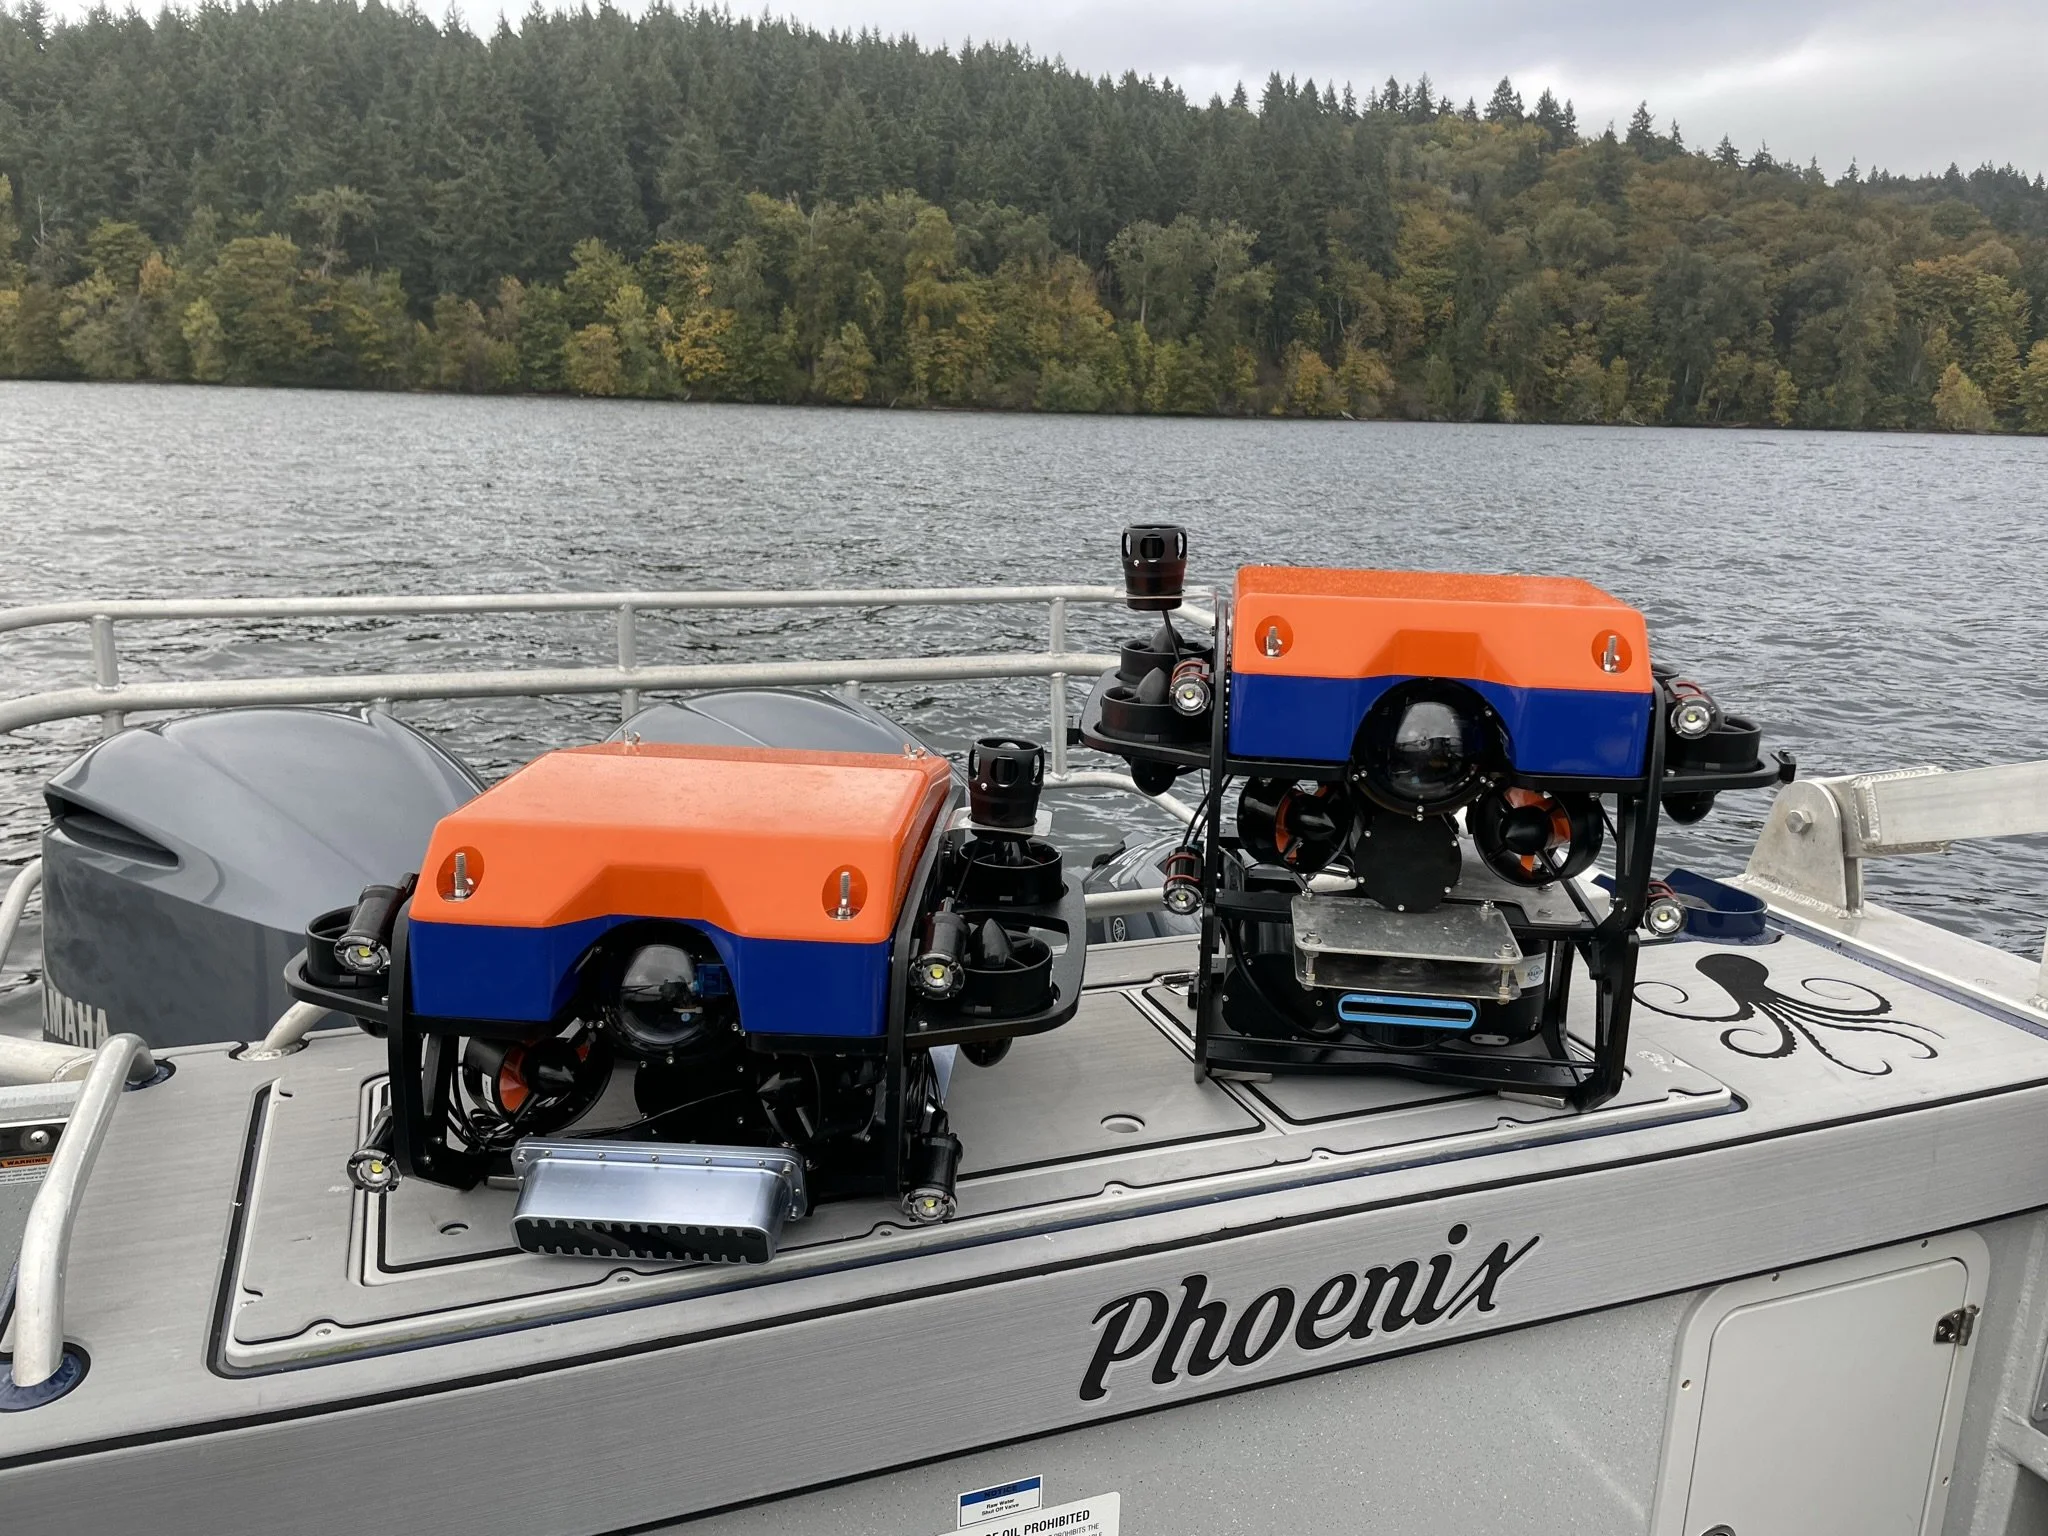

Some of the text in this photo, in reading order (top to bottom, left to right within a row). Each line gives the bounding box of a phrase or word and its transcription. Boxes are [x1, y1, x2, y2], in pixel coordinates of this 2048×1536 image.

[7, 1158, 47, 1166] WARNING
[1080, 1223, 1540, 1401] Phoenix
[984, 1485, 1018, 1498] NOTICE
[999, 1498, 1015, 1506] Water
[1002, 1509, 1090, 1536] OIL PROHIBITED
[1088, 1522, 1100, 1531] THE
